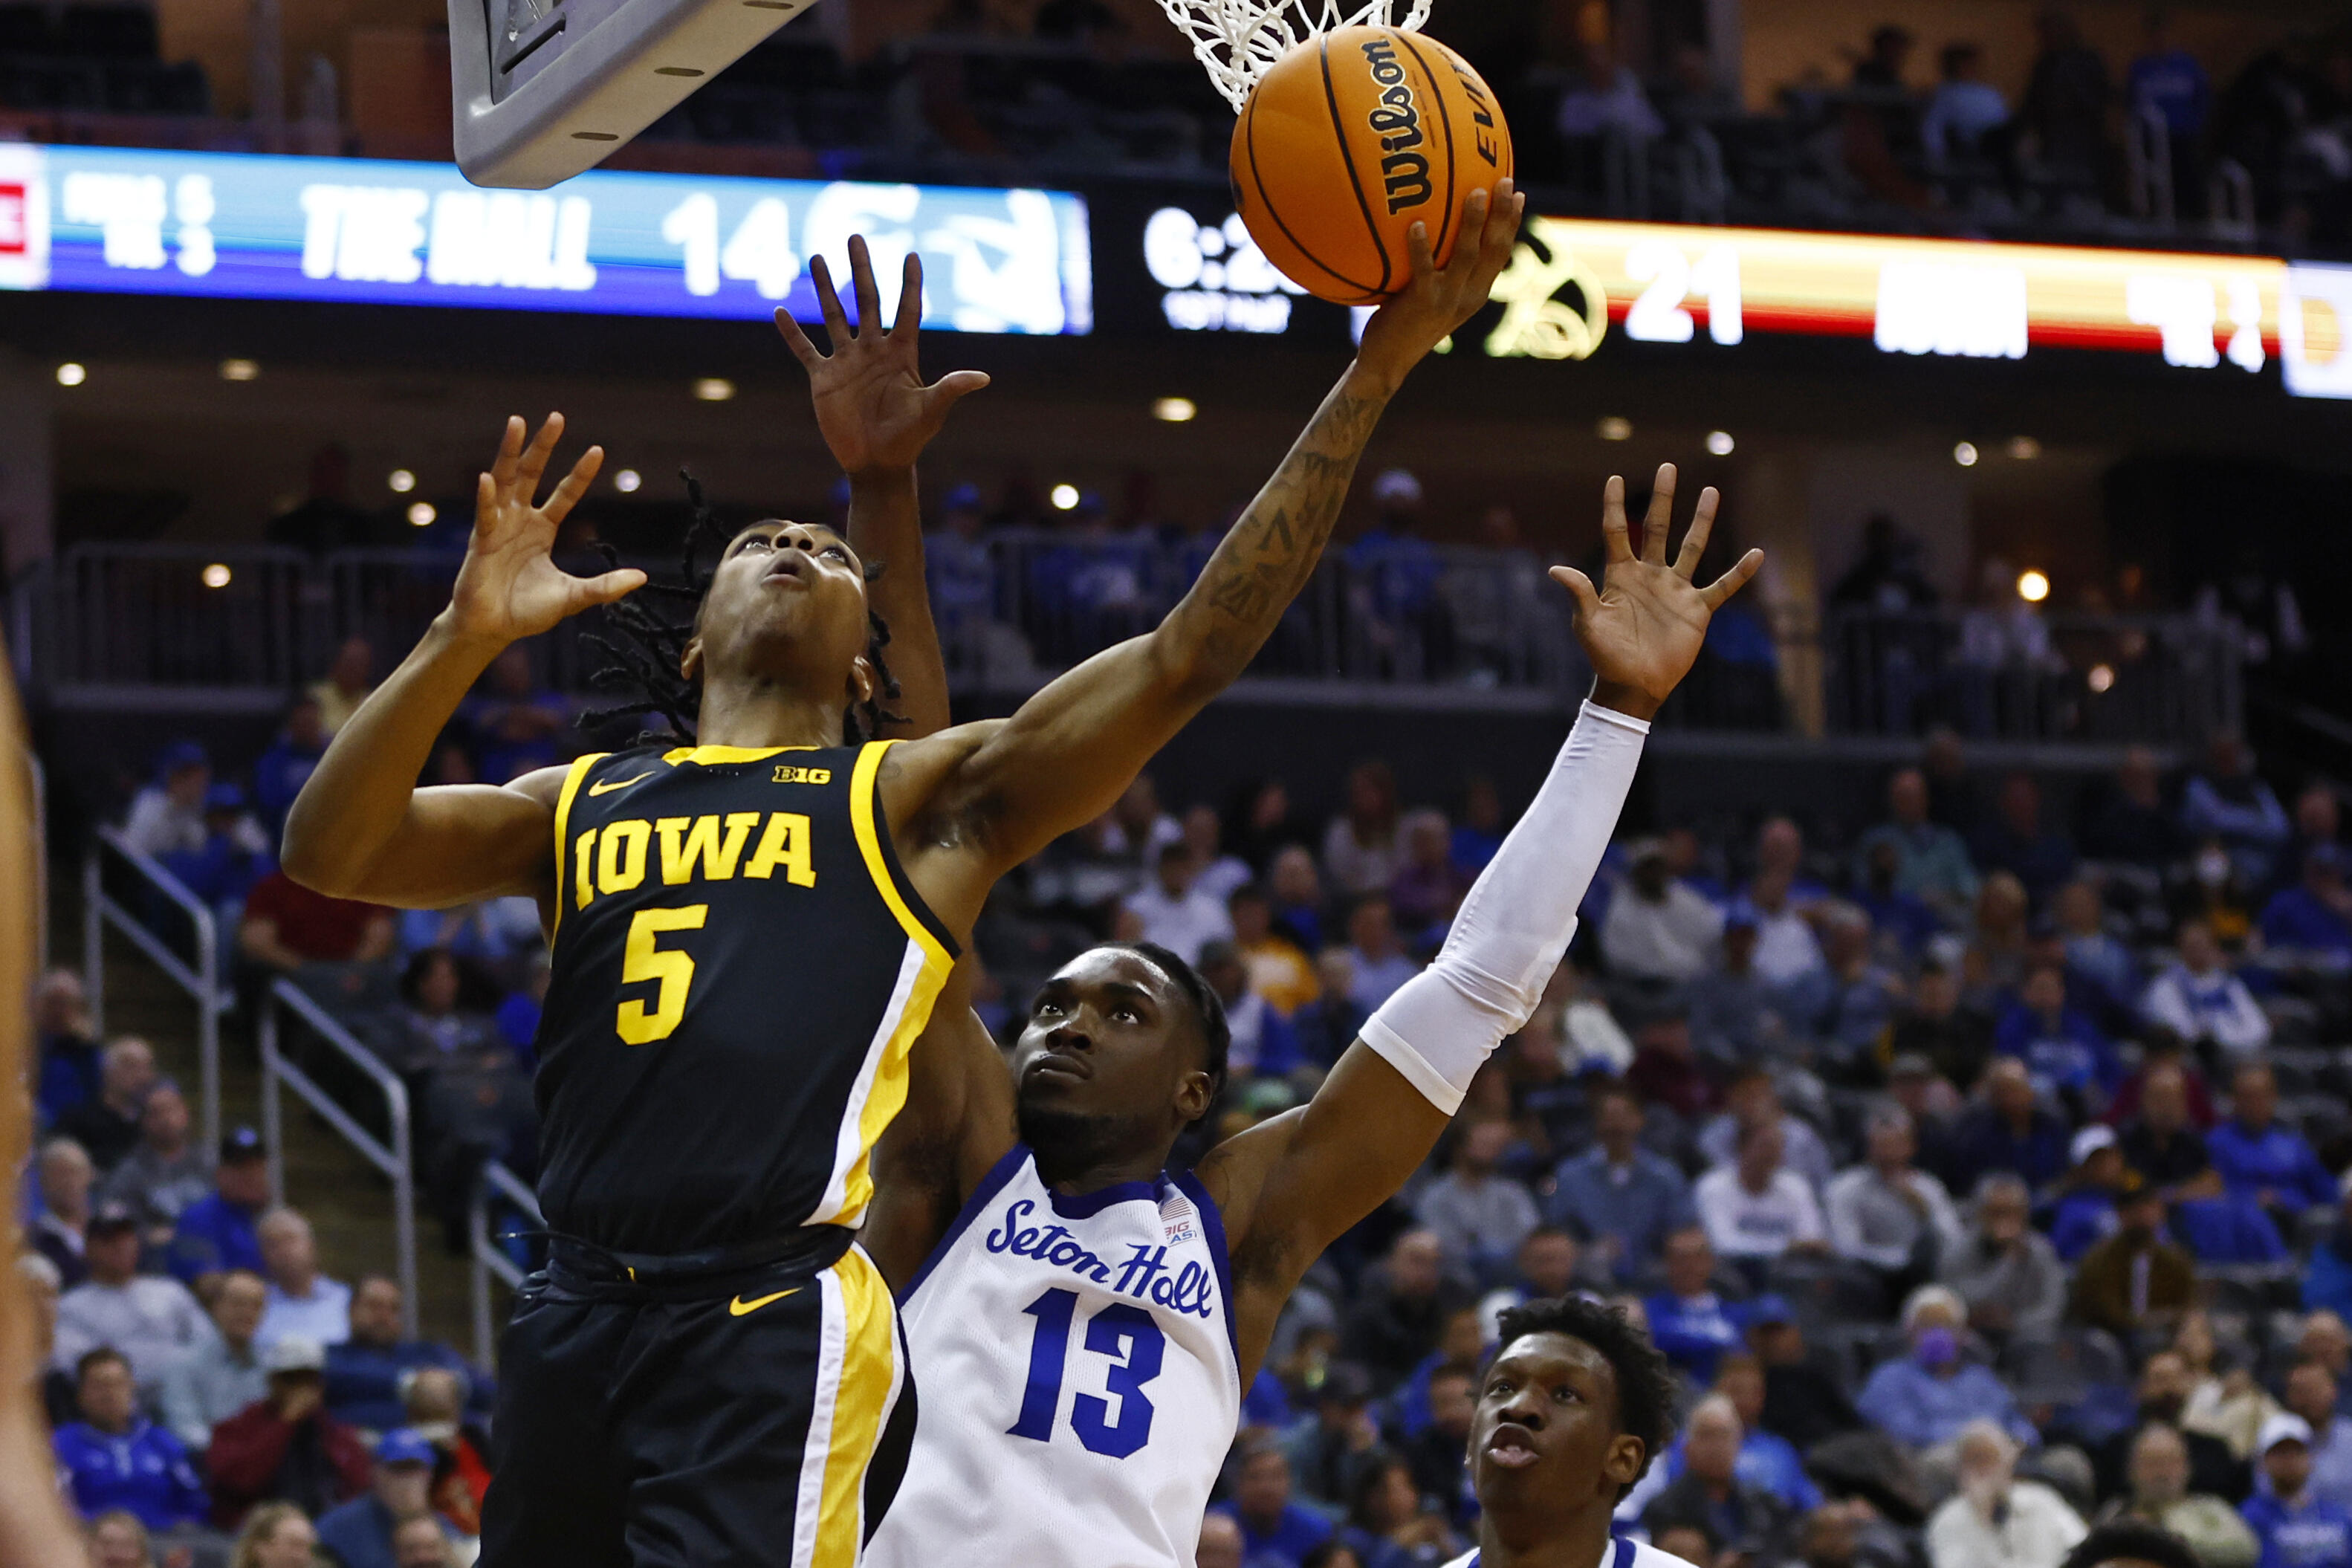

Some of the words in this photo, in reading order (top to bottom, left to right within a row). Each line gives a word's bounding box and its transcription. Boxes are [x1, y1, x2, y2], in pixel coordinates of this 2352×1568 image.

[1361, 39, 1433, 216] Wilson
[661, 192, 801, 300] 14
[1144, 205, 1311, 296] 6:2
[1624, 239, 1743, 346] 21
[771, 765, 832, 785] BIG
[575, 811, 817, 912] IOWA
[615, 904, 709, 1046] 5
[985, 1199, 1111, 1283] Seton
[1113, 1243, 1212, 1319] Hall
[1005, 1286, 1166, 1460] 13
